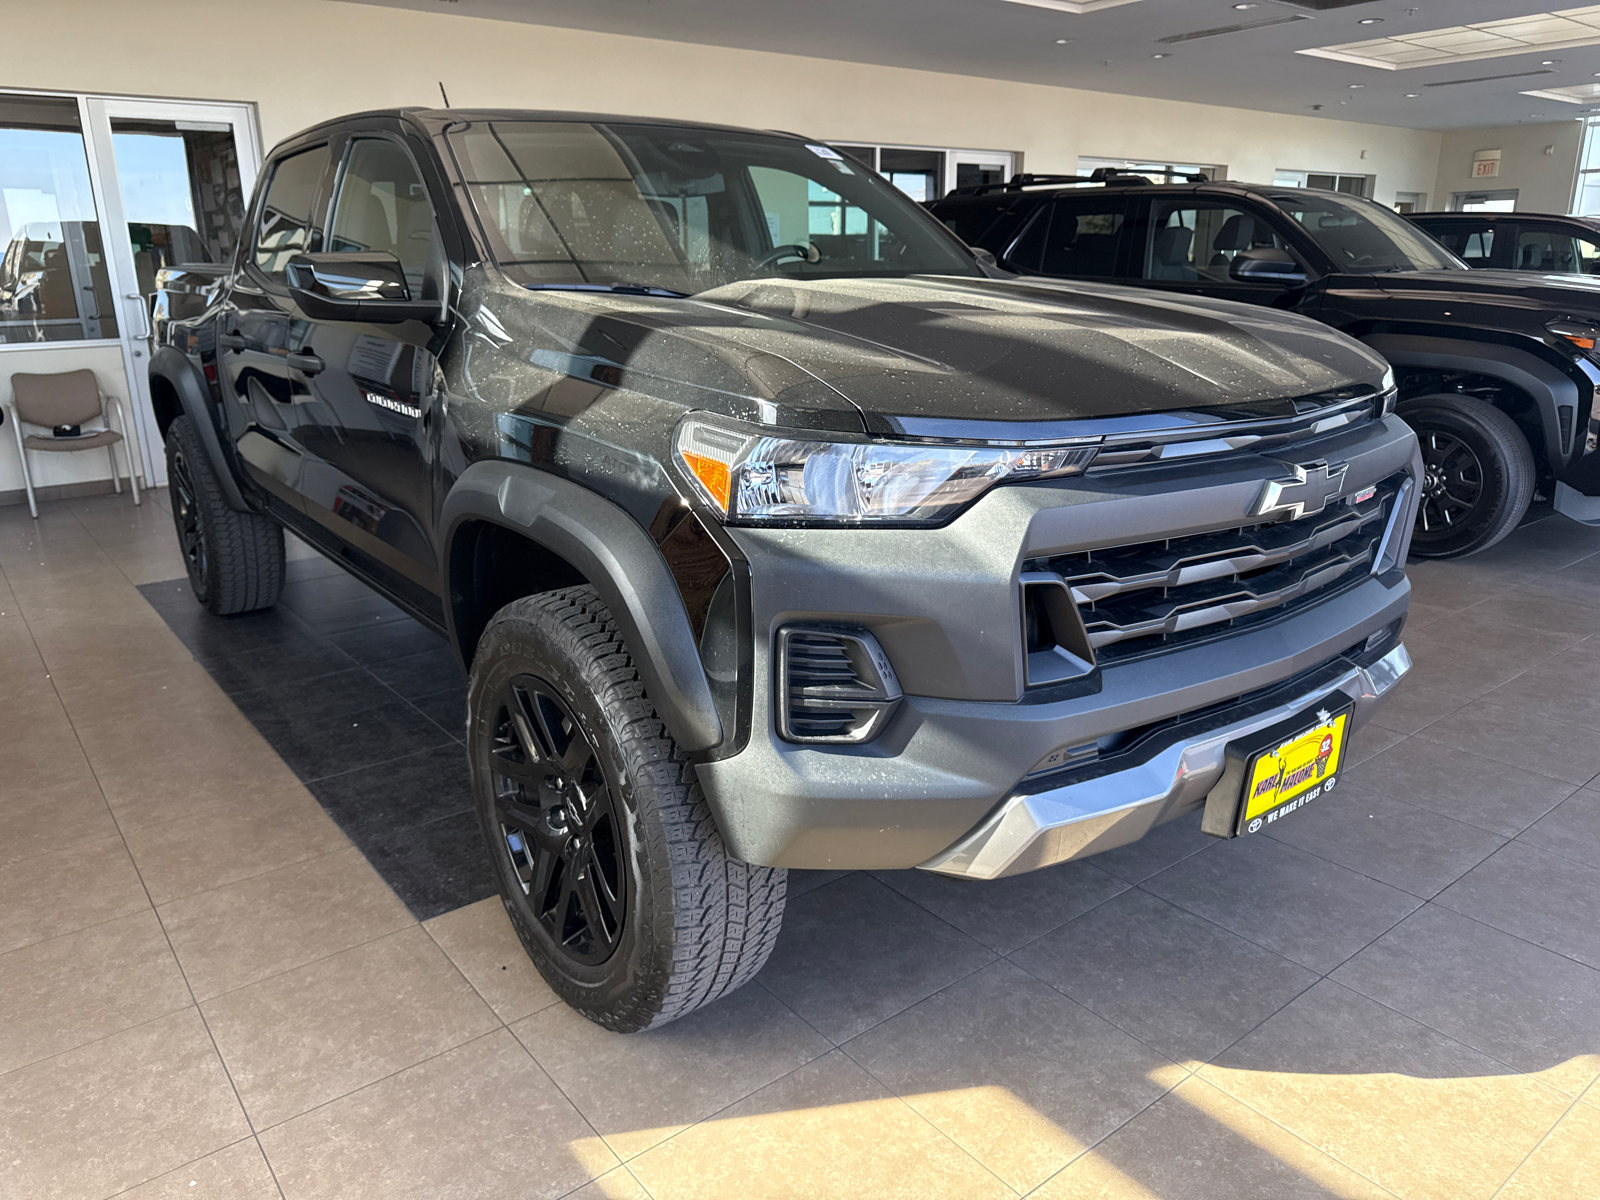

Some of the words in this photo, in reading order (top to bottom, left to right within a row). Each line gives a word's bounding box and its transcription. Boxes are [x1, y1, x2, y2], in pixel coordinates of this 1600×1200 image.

[1476, 162, 1495, 176] EXIT
[1320, 738, 1331, 753] 32
[1252, 772, 1279, 800] KARL
[1279, 762, 1316, 794] MALONE
[1267, 810, 1279, 824] WE
[1279, 800, 1298, 818] MAKE
[1298, 796, 1306, 808] IT
[1305, 786, 1321, 803] EASY
